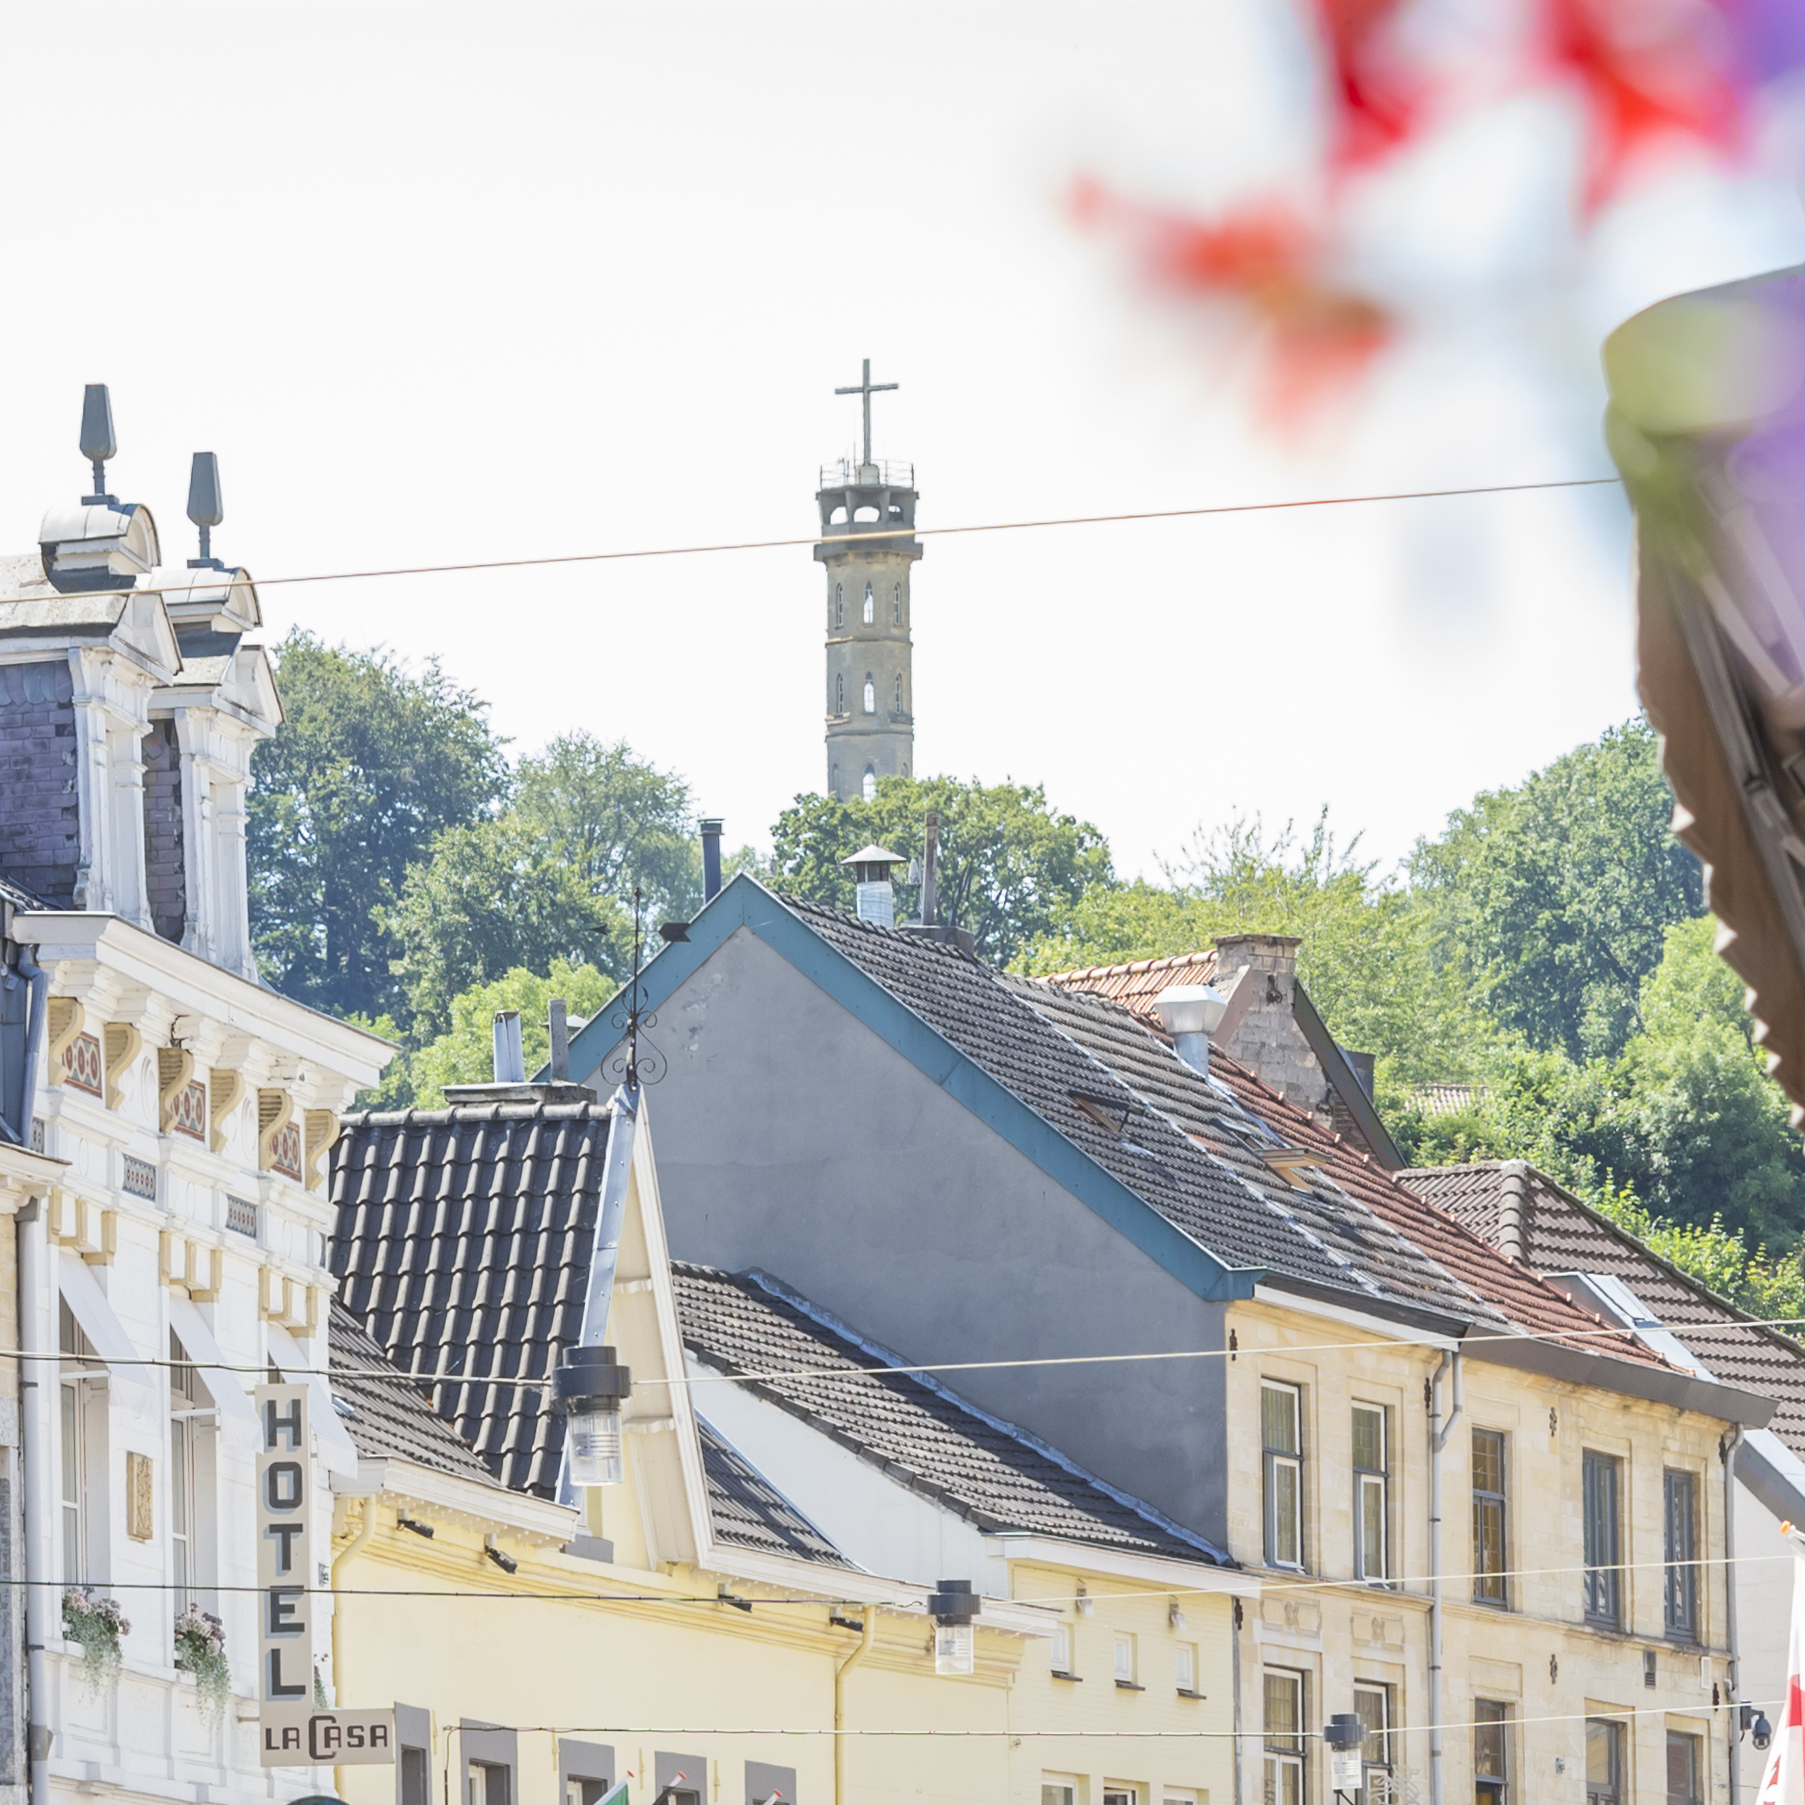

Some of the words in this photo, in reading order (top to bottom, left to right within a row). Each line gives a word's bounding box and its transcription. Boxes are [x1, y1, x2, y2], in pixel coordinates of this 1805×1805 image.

[264, 1398, 307, 1698] HOTEL
[265, 1727, 300, 1750] LA
[308, 1715, 388, 1760] CASA
